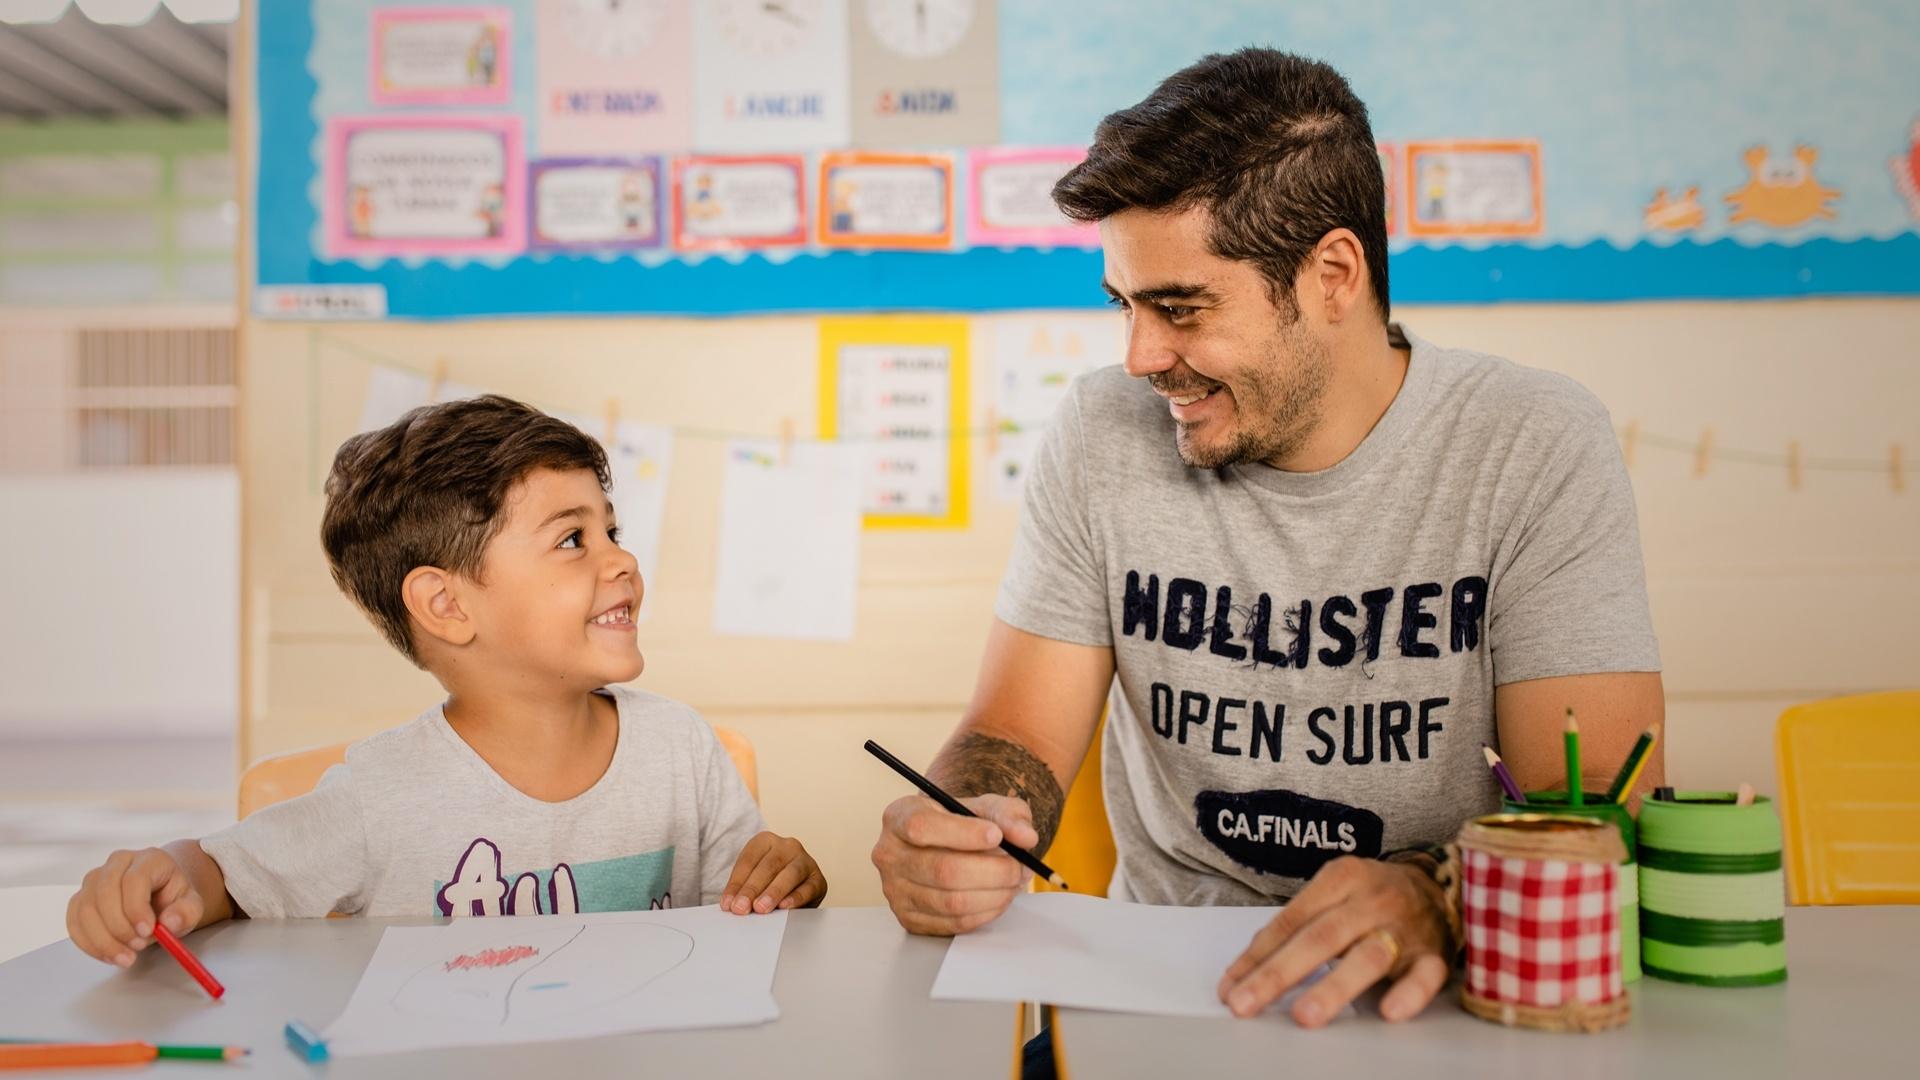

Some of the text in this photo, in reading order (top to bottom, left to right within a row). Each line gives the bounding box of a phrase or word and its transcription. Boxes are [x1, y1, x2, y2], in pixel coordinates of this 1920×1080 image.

[1122, 569, 1488, 669] HOLLISTER
[1151, 682, 1450, 765] OPEN SURF
